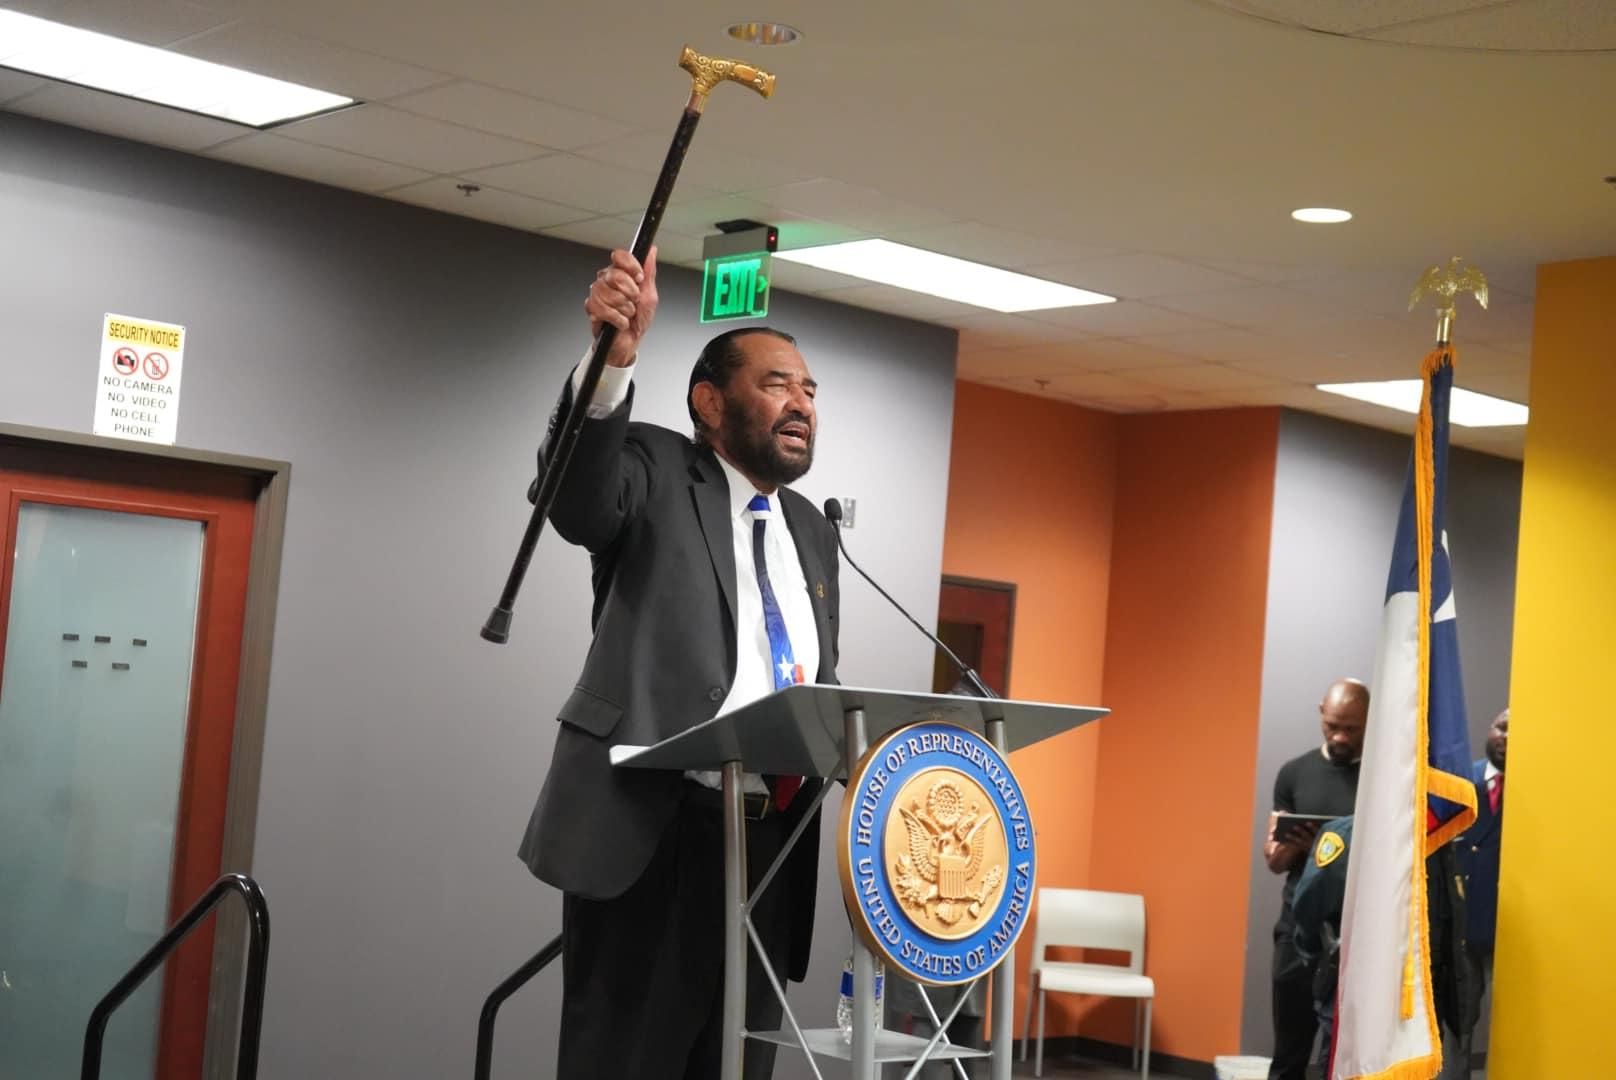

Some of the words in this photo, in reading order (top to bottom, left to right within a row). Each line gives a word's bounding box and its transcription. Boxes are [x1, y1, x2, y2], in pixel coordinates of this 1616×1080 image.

[713, 258, 762, 316] EXIT
[109, 322, 148, 342] SECURITY
[150, 330, 179, 348] NOTICE
[103, 375, 121, 387] NO
[124, 380, 173, 395] CAMERA
[107, 392, 125, 403] NO
[132, 395, 167, 409] VIDEO
[111, 408, 128, 418] NO
[131, 410, 160, 424] CELL
[114, 423, 155, 437] PHONE
[856, 768, 890, 847] HOUSE
[886, 744, 907, 771] OF
[907, 732, 1030, 852] REPRESENTATIVES
[857, 856, 901, 946] UNITED
[900, 939, 962, 975] STATES
[966, 945, 986, 971] OF
[990, 861, 1030, 957] AMERICA
